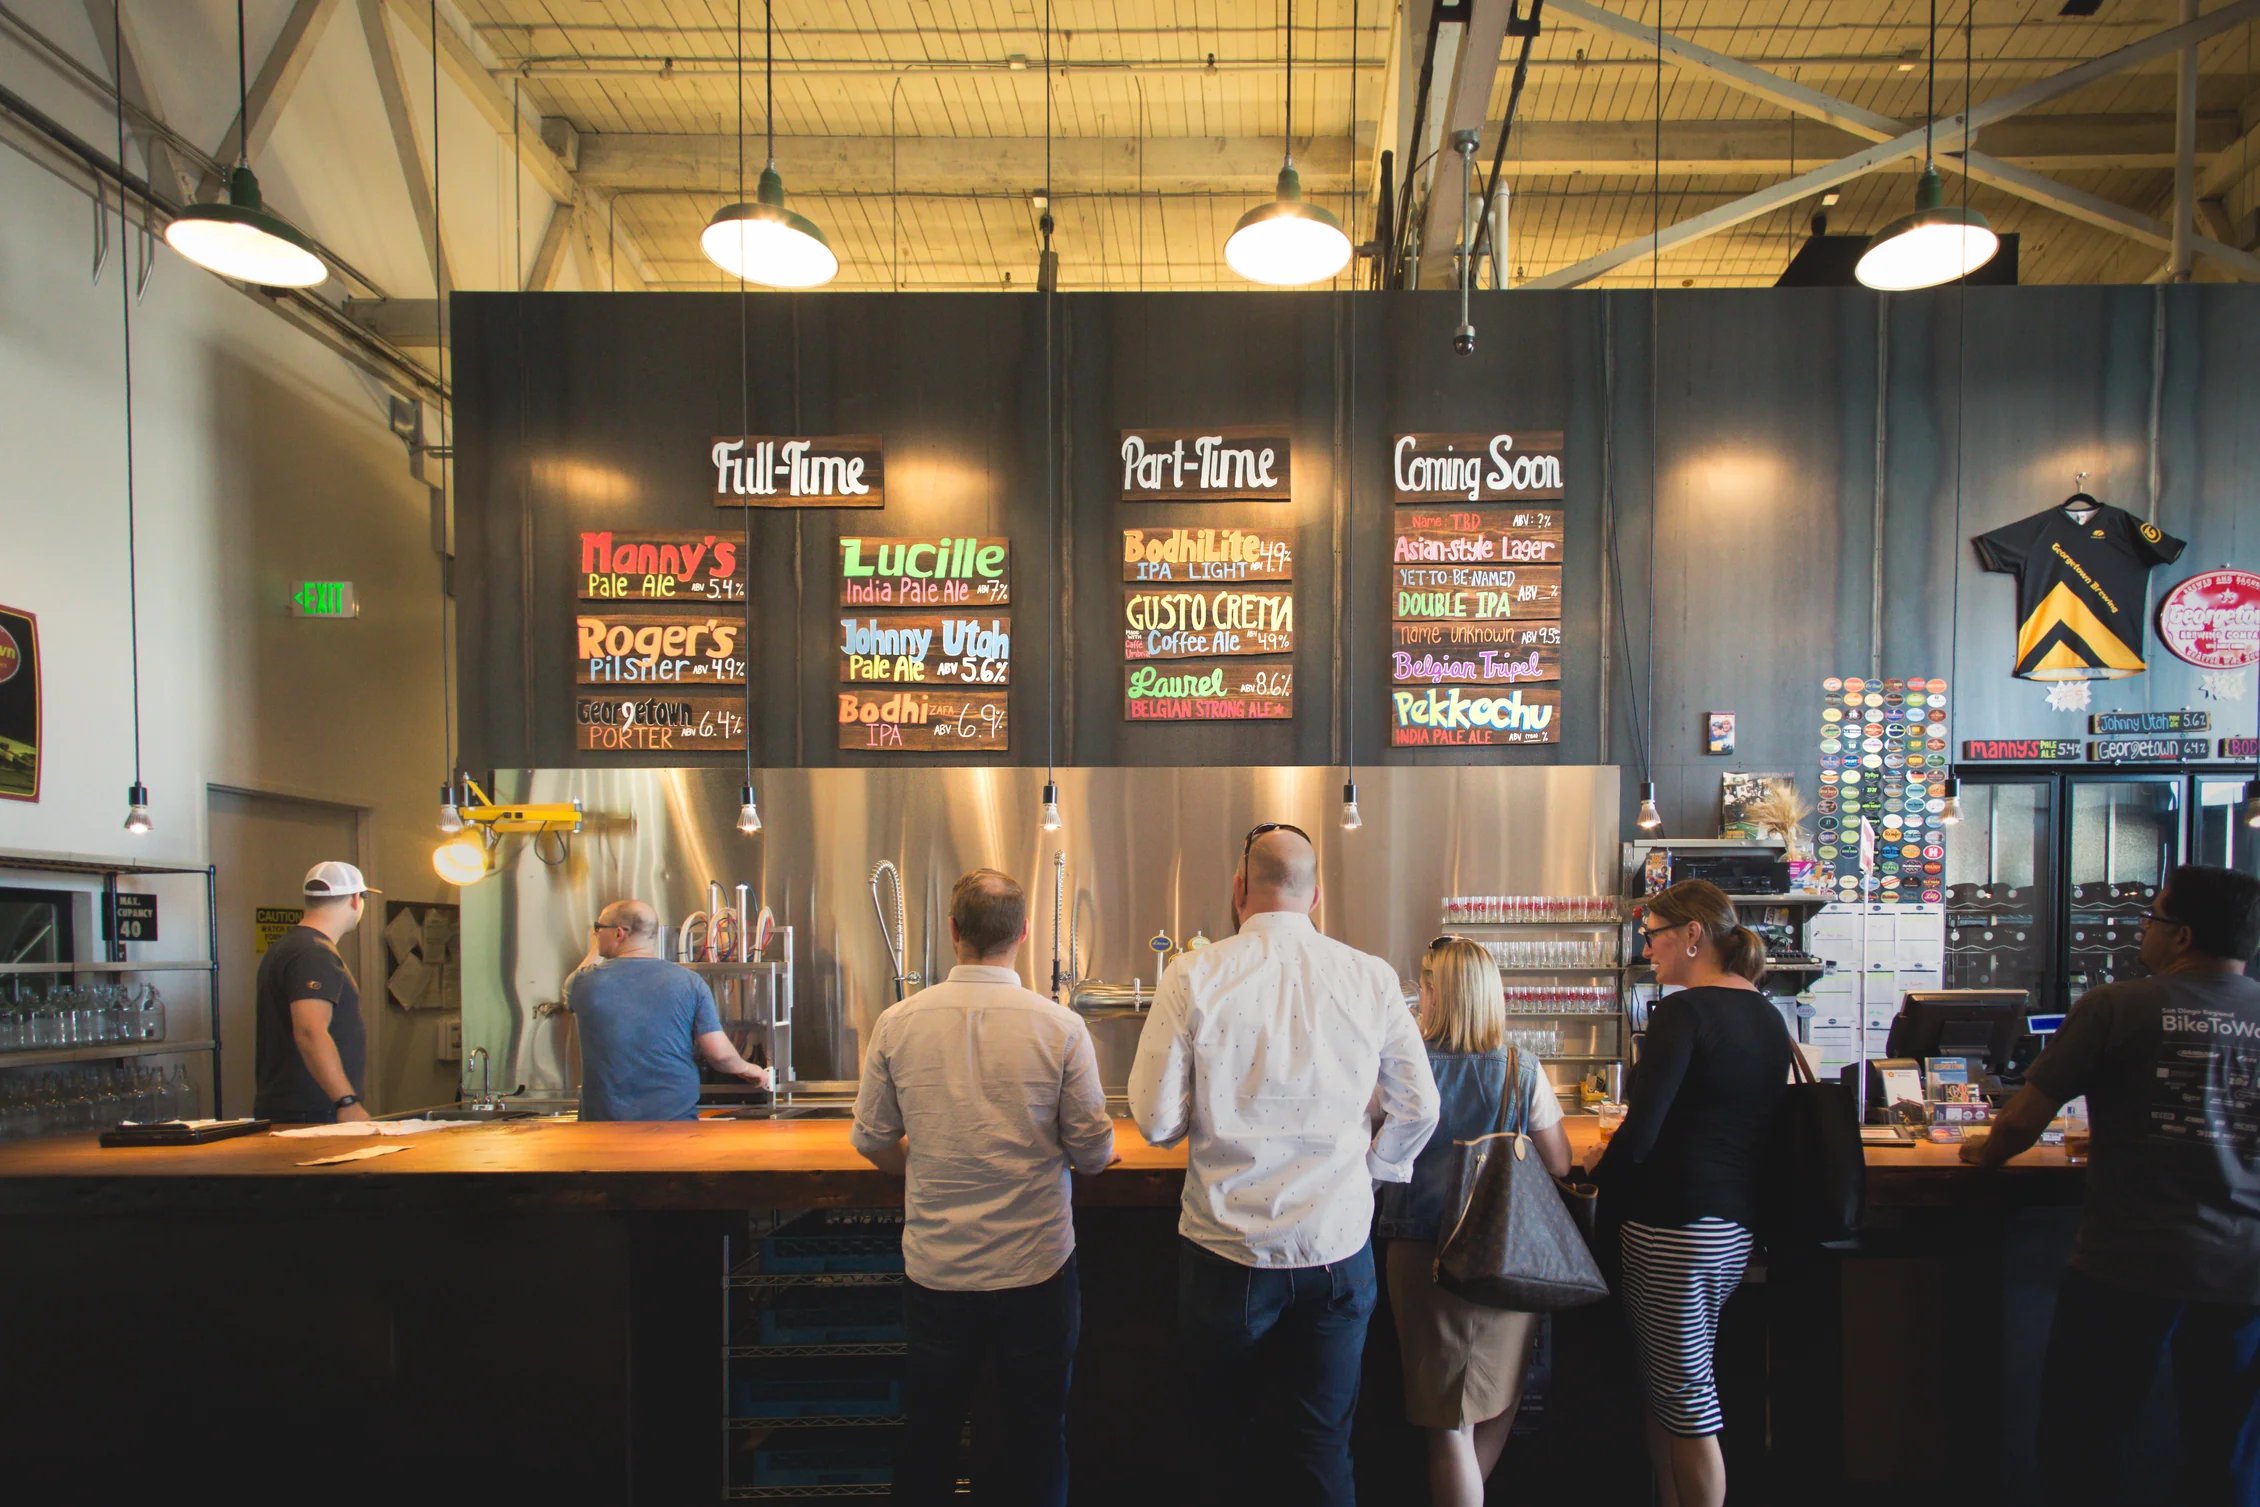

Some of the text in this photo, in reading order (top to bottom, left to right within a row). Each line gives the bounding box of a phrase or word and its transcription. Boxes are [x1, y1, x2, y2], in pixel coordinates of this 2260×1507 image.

[712, 439, 870, 496] Full-Time
[1122, 435, 1278, 490] Part-Time
[1394, 434, 1564, 501] Coming Soon
[1450, 514, 1481, 531] TBD
[580, 532, 736, 582] Manny's
[840, 537, 1005, 579] Lucille
[1260, 541, 1292, 572] 4.9%
[1394, 535, 1556, 562] Asian-style Lager
[1136, 562, 1248, 580] IPA LIGHT
[2052, 542, 2118, 614] Georgetown Brewing
[304, 582, 344, 614] EXIT
[589, 573, 744, 599] Pale Ale ABV 5.4%
[847, 577, 1008, 604] India Pale Ale ABV 7%
[1126, 591, 1293, 632] GUSTO CREMA
[1399, 591, 1510, 618] DOUBLE IPA
[2169, 602, 2260, 627] Georgeto
[576, 618, 738, 667] Roger's
[840, 619, 1009, 664] Johnny Utah
[1148, 630, 1210, 654] Coffee
[1212, 630, 1240, 653] Ale
[1258, 634, 1290, 650] 4.9%
[1521, 631, 1537, 644] ABV
[590, 656, 744, 681] Pilsner ABV 4.9%
[850, 655, 1008, 684] Pale Ale ABV 5.6%
[1392, 650, 1544, 684] Belgian Tripel
[1127, 666, 1292, 699] Laurel ABV 8.6%
[576, 698, 742, 739] Georgetown ABV 6.4%
[838, 693, 929, 724] Bodhi
[934, 725, 952, 736] ABV
[958, 703, 1004, 738] 6.9%
[1131, 700, 1273, 718] BELGIAN STRONG ALE
[2100, 713, 2206, 731] Johnny Utah 5.6%
[590, 726, 673, 749] PORTER
[866, 723, 902, 746] IPA
[1395, 729, 1429, 745] INDIA
[1432, 728, 1466, 745] PALE
[1465, 730, 1492, 744] ALE
[1508, 732, 1522, 742] ABV
[2040, 740, 2057, 750] PALE
[2057, 742, 2081, 755] 5.4%
[2040, 750, 2056, 758] ALE
[2099, 740, 2206, 760] Georgetown 6.4%
[117, 908, 153, 918] CUPANCY
[258, 910, 302, 922] CAUTION
[120, 920, 142, 938] 40
